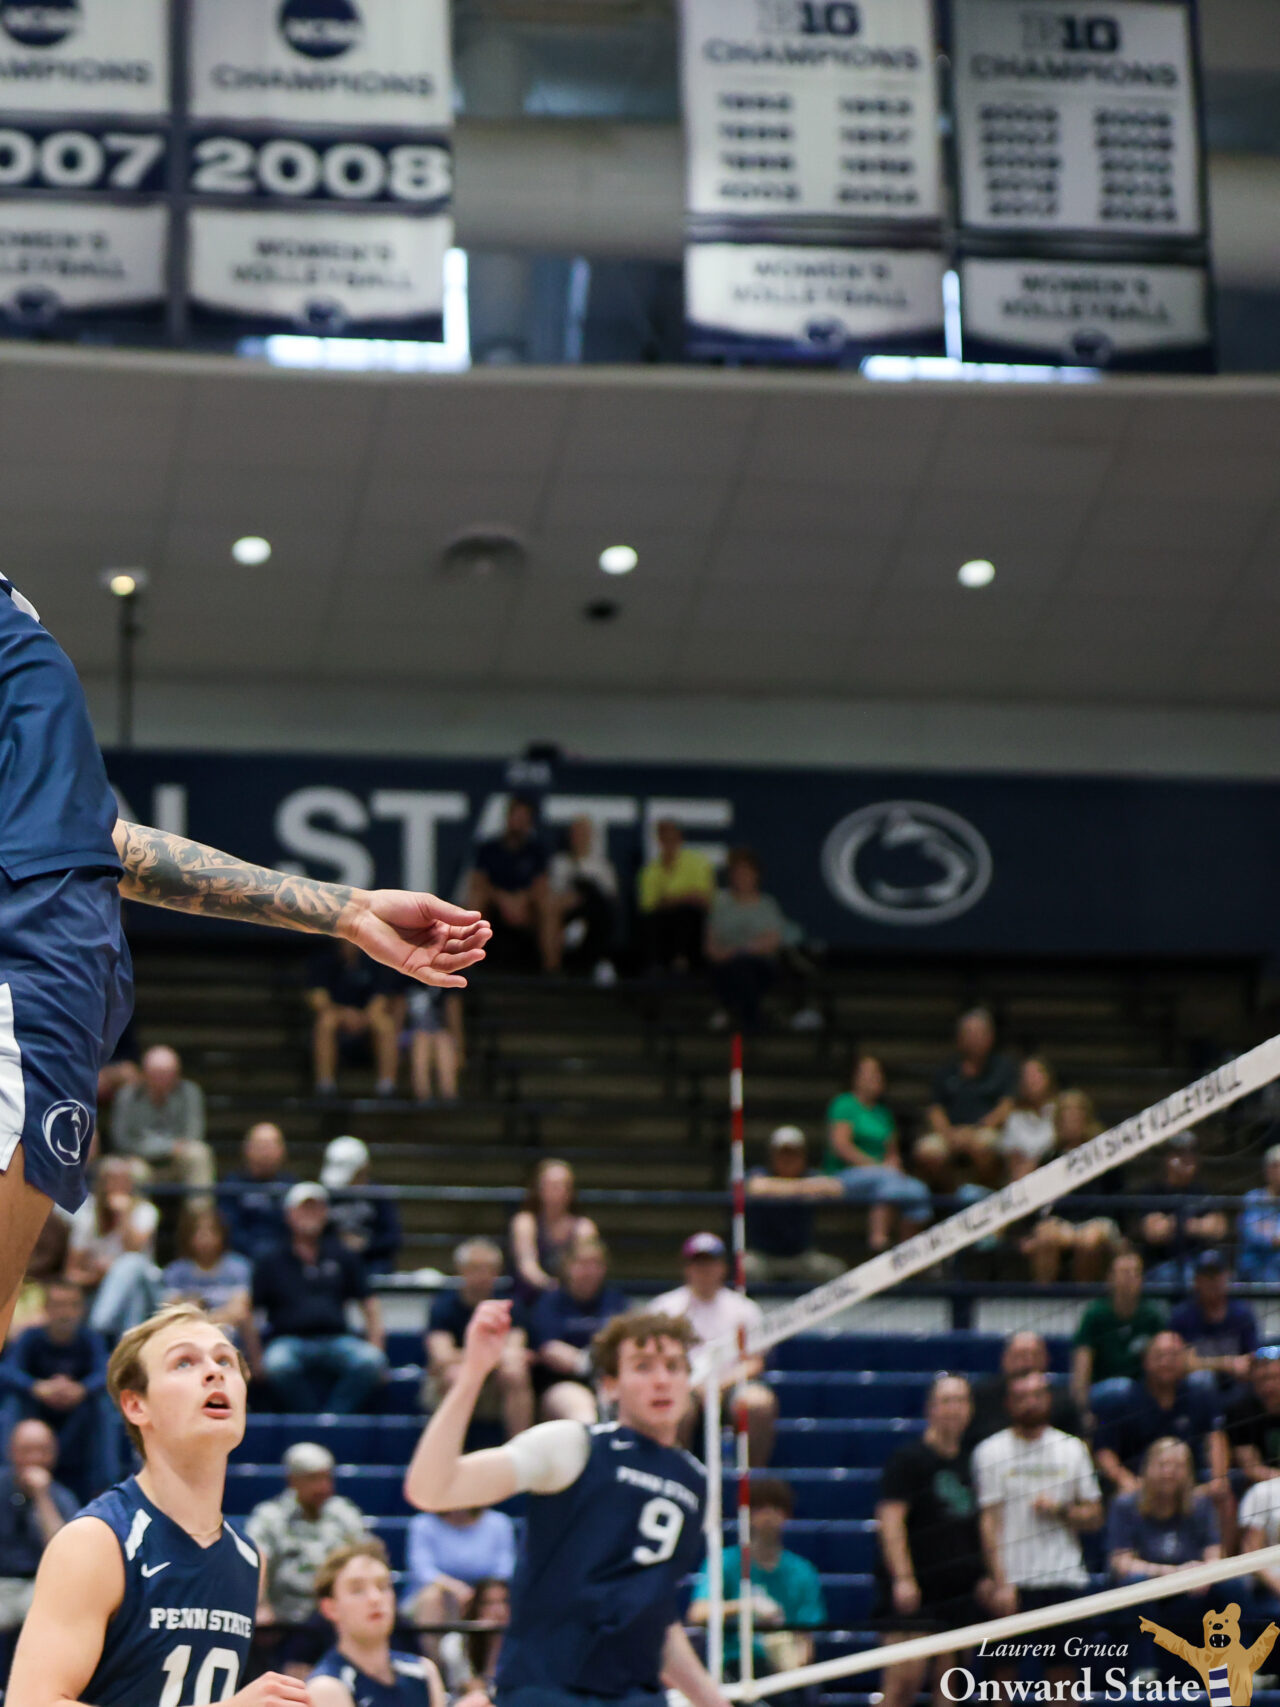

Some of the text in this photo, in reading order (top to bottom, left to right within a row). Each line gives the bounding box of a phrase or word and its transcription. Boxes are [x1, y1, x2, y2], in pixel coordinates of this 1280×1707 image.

[212, 63, 437, 97] CHAMPIONS
[190, 137, 453, 201] 2008
[616, 1465, 663, 1492] PENN
[632, 1496, 685, 1565] 9
[149, 1607, 253, 1639] PENN STATE
[158, 1644, 240, 1707] 10
